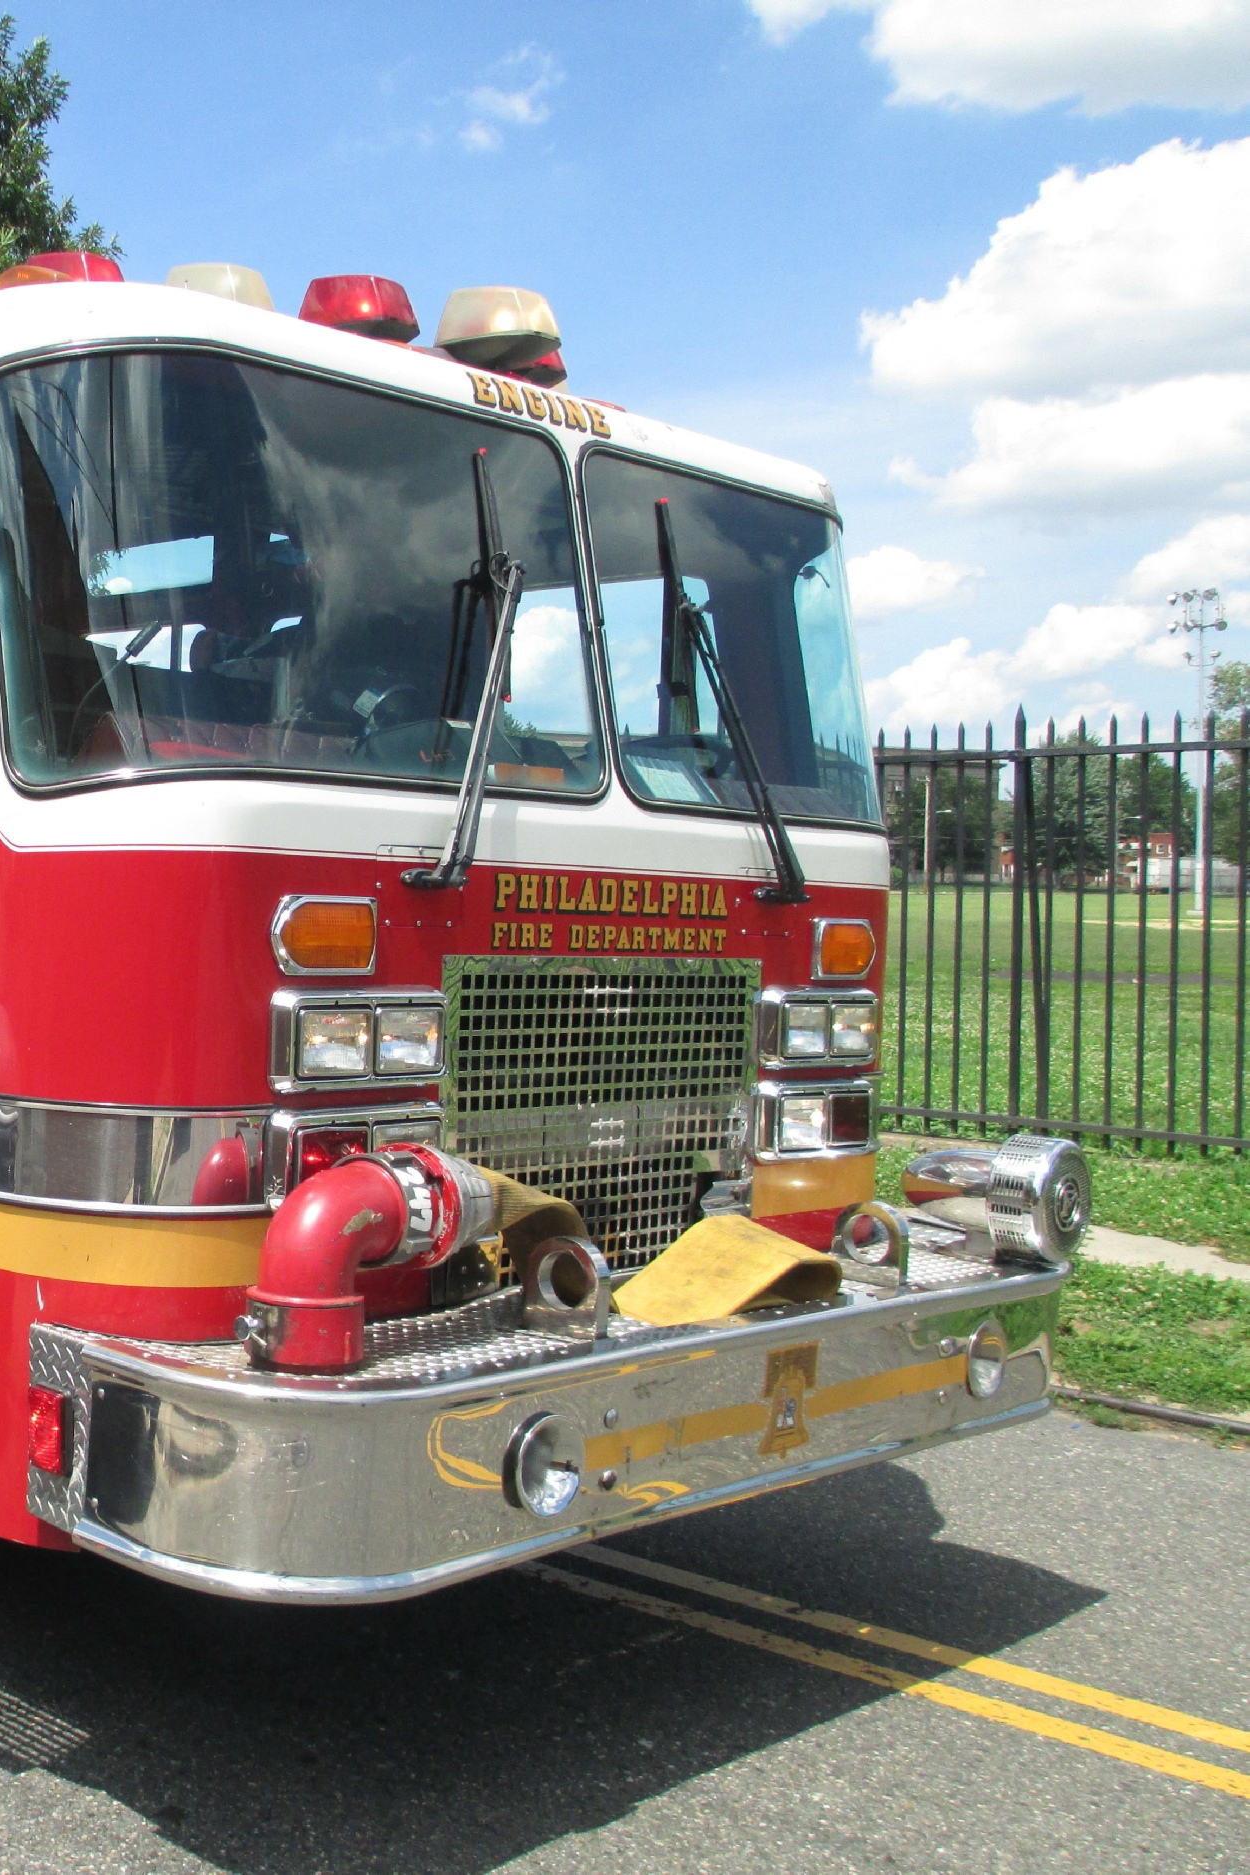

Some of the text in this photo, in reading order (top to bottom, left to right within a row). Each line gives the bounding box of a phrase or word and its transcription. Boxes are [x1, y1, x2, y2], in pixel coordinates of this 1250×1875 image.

[466, 372, 611, 439] ENGINE
[495, 873, 728, 919] PHILADELPHIA
[492, 922, 727, 953] FIRE DEPARTMENT
[393, 1167, 432, 1231] 247
